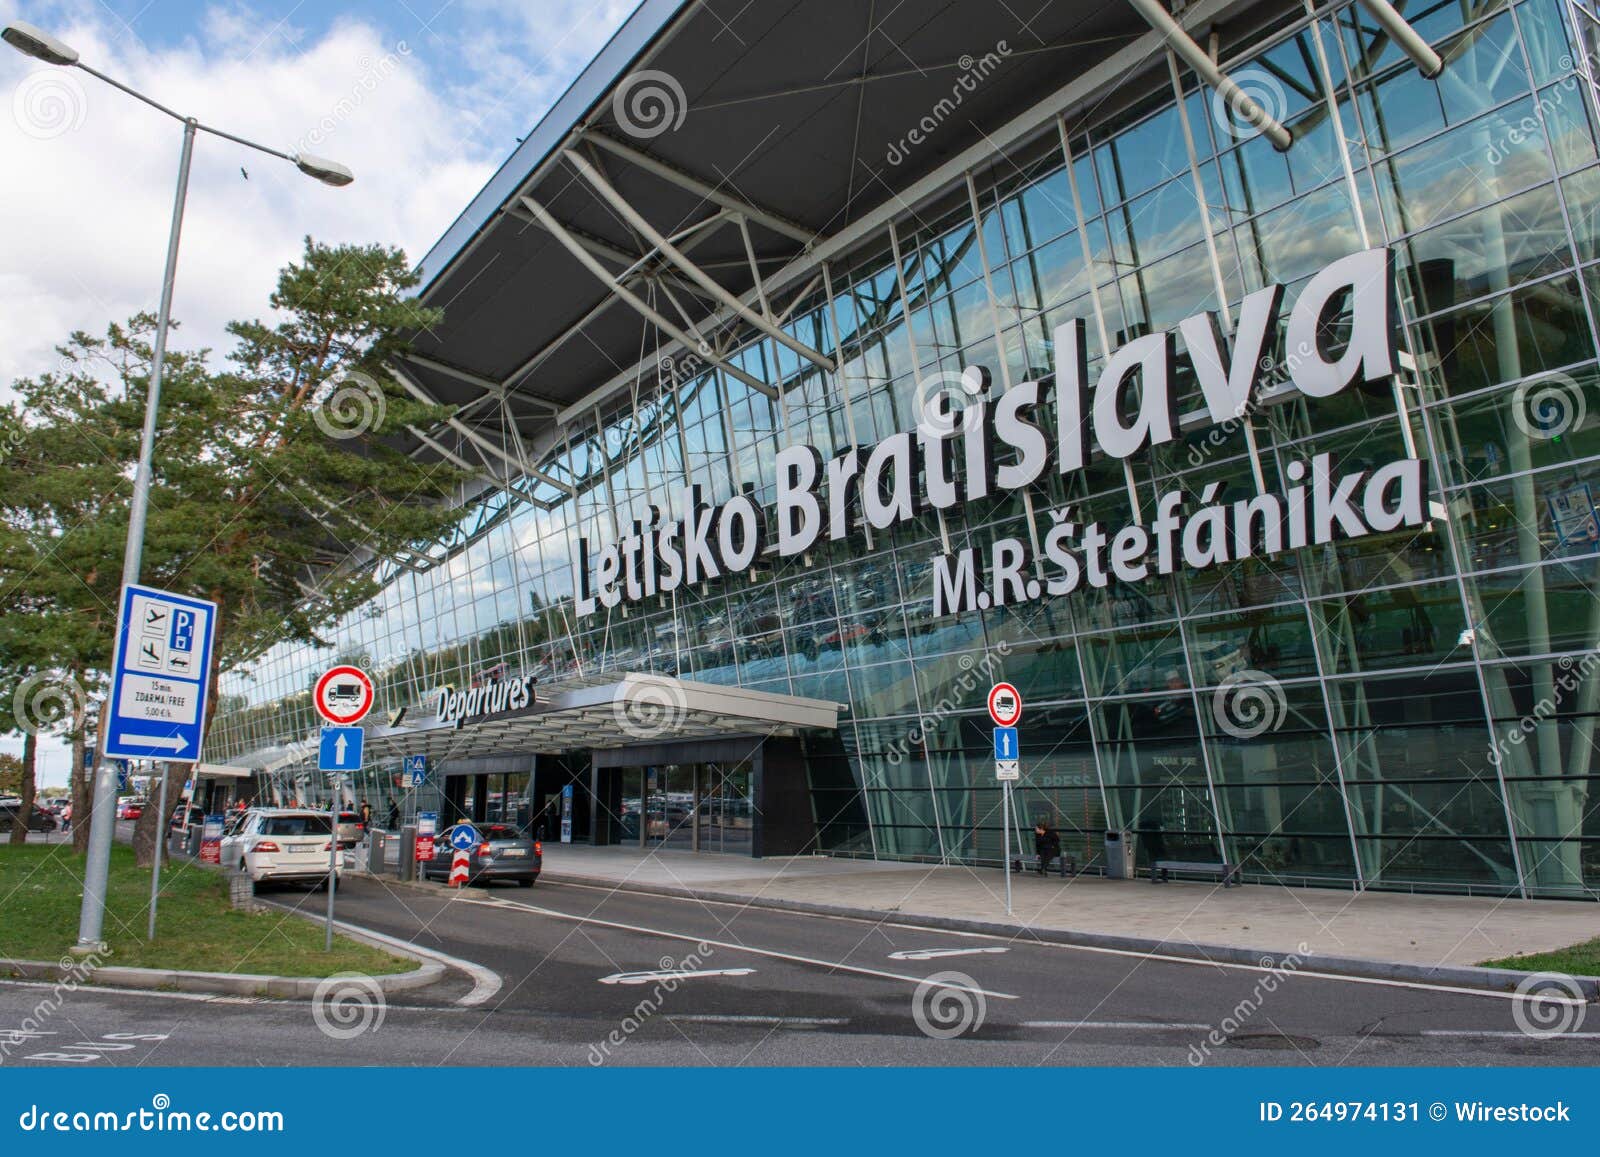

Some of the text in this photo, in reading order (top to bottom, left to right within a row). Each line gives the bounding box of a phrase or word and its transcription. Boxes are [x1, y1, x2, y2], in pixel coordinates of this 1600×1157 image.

[574, 247, 1394, 617] Letisko Bratislava
[436, 676, 532, 729] Departures
[24, 1032, 169, 1063] BUS
